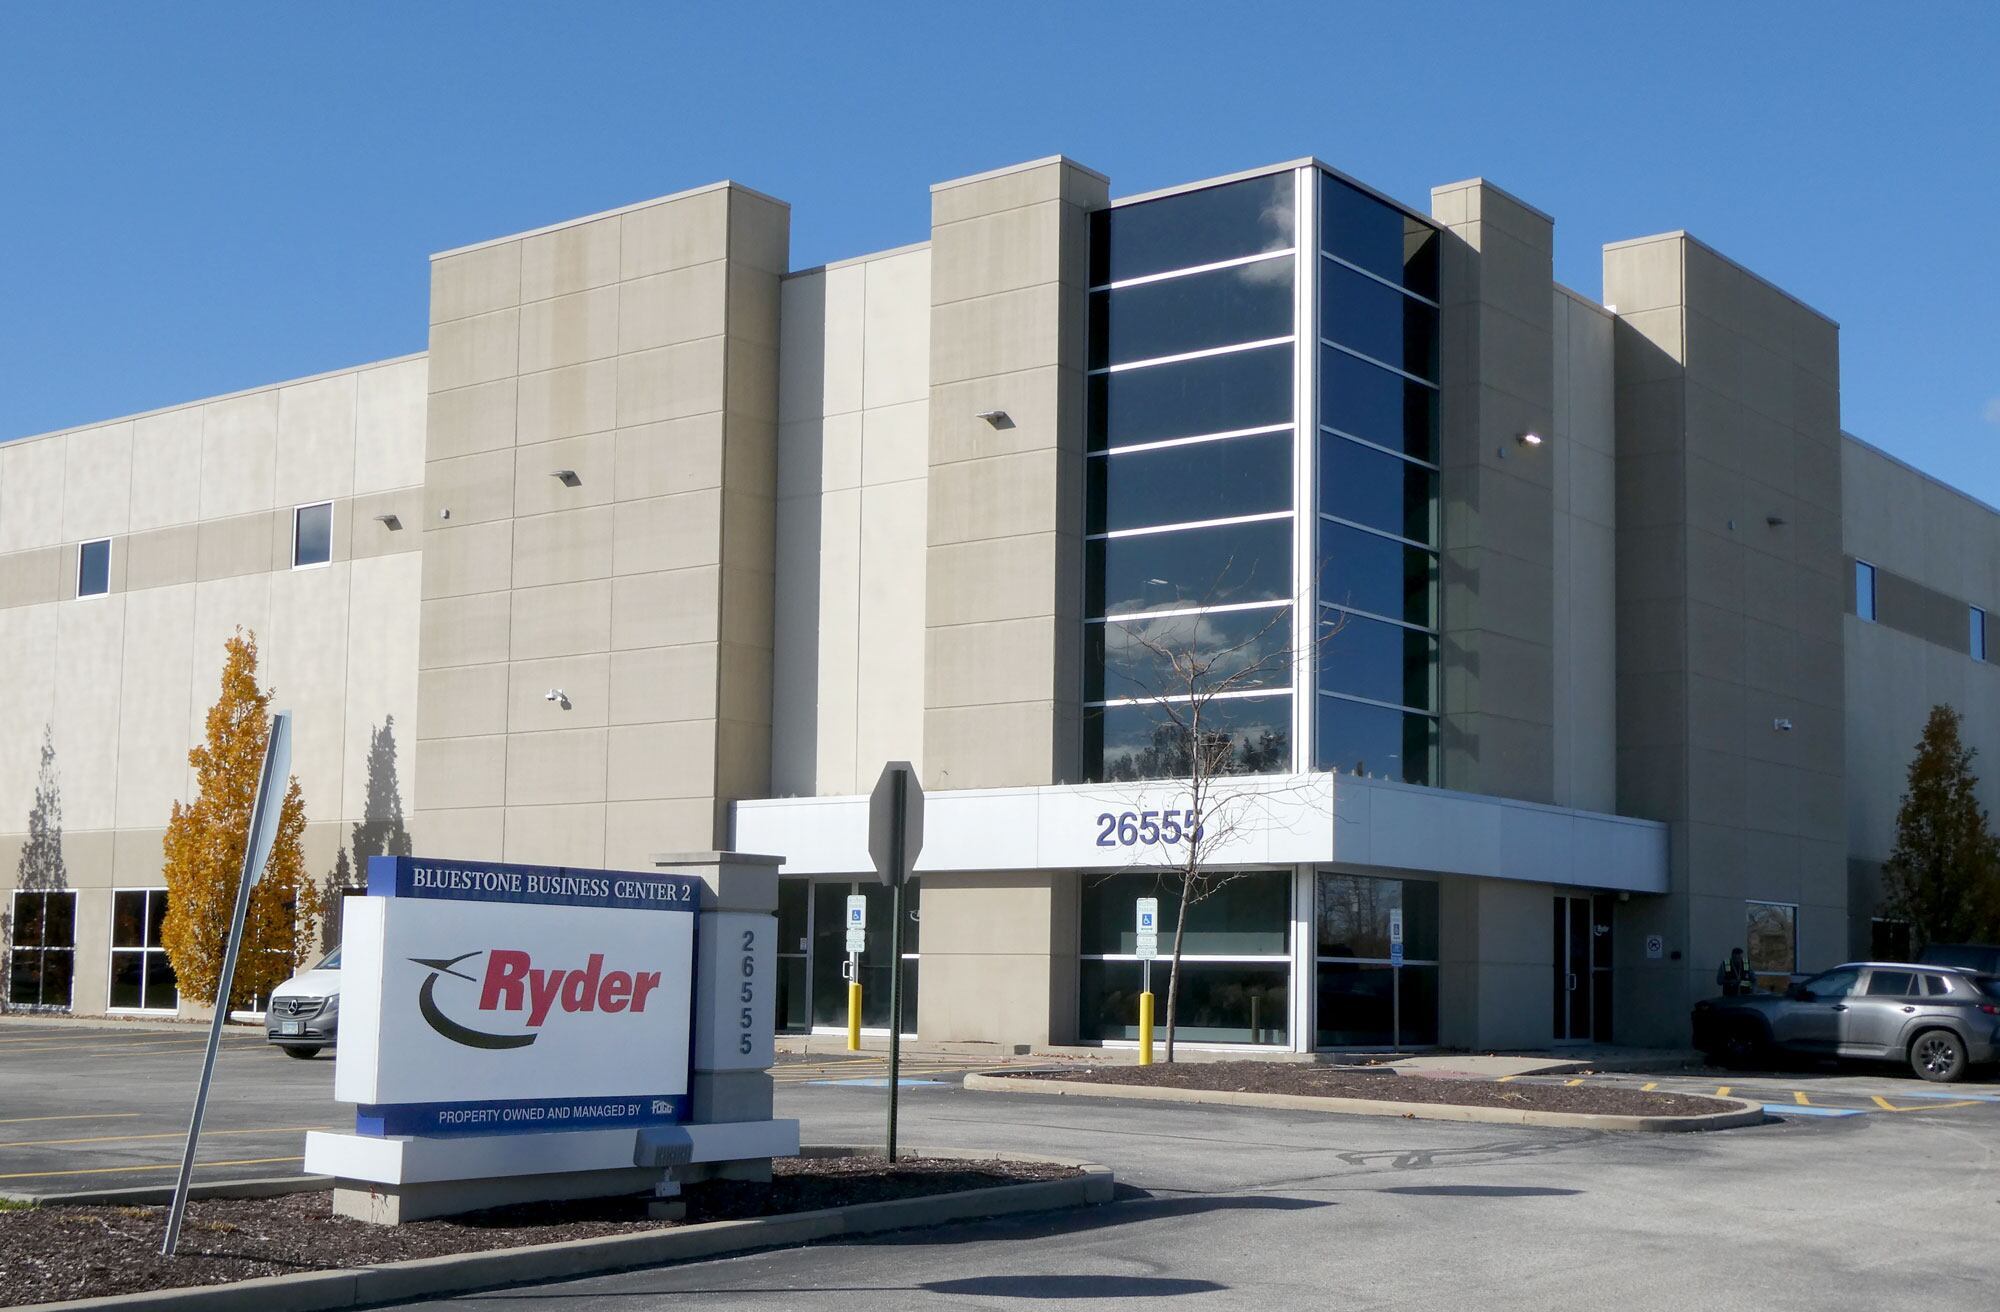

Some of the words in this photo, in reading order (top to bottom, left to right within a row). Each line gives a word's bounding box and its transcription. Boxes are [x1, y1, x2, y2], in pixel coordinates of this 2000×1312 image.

[1096, 809, 1204, 847] 26555
[412, 867, 522, 892] BLUESTONE
[526, 875, 610, 897] BUSINESS
[614, 880, 678, 901] CENTER
[681, 884, 692, 902] 2
[478, 949, 662, 1027] Ryder
[740, 930, 755, 1055] 26555
[439, 1109, 501, 1124] PROPERTY
[502, 1107, 545, 1121] OWNED
[547, 1106, 571, 1120] AND
[573, 1104, 626, 1118] MANAGED
[628, 1103, 641, 1116] BY
